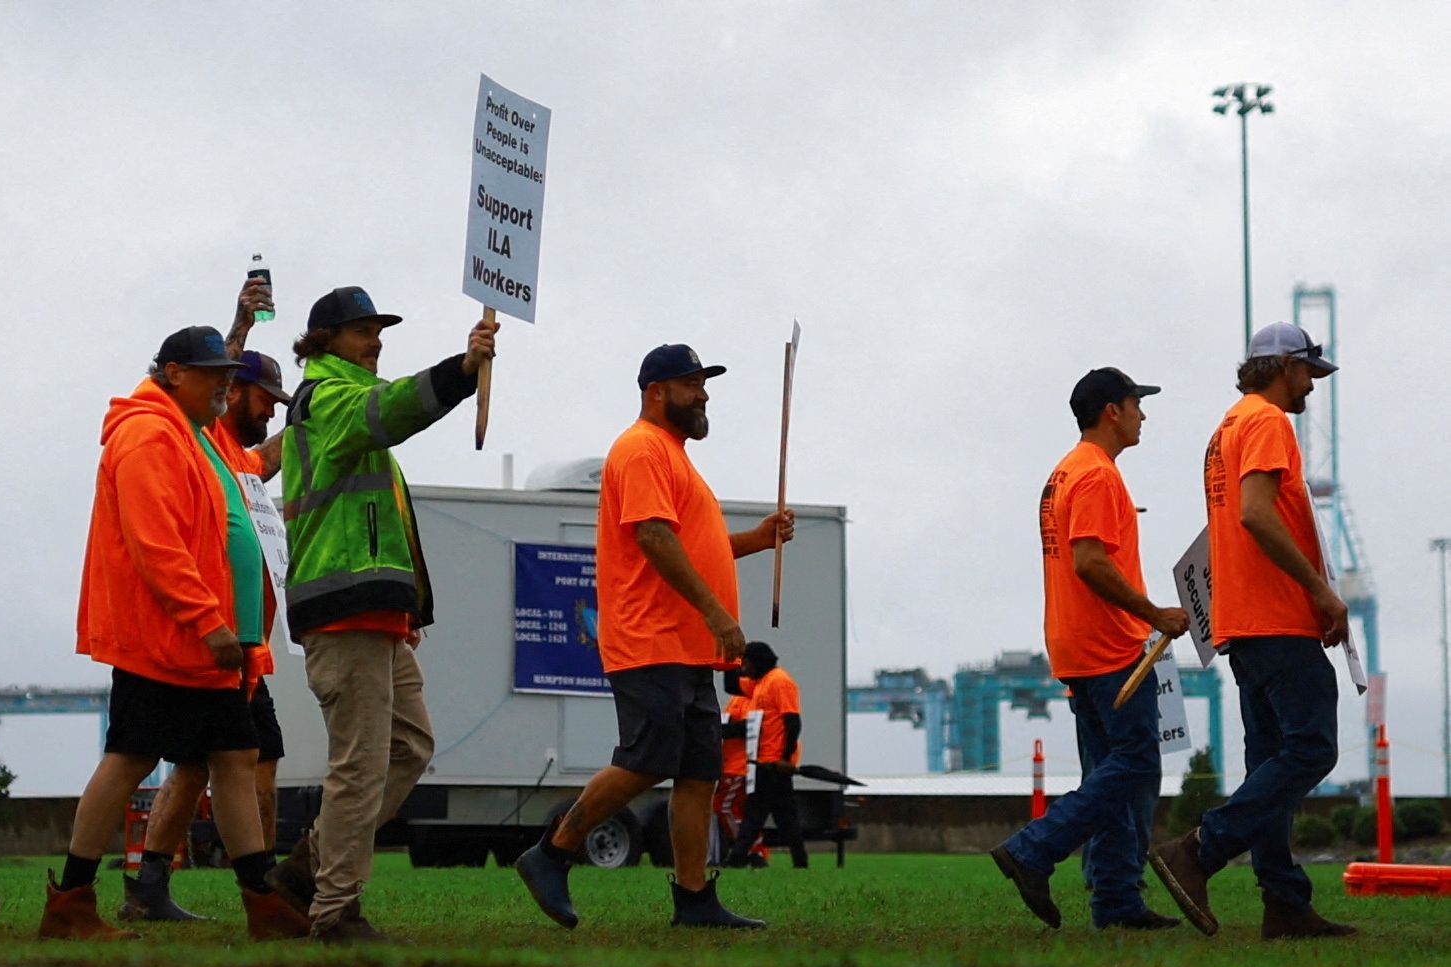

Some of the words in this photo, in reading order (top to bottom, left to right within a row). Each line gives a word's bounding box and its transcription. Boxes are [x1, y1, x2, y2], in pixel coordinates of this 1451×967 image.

[485, 96, 509, 122] Profit
[511, 111, 536, 134] Over
[486, 120, 518, 148] People
[520, 136, 529, 155] is
[477, 184, 533, 231] Support
[488, 227, 511, 259] ILA
[472, 254, 532, 304] Workers
[1184, 563, 1212, 643] Security
